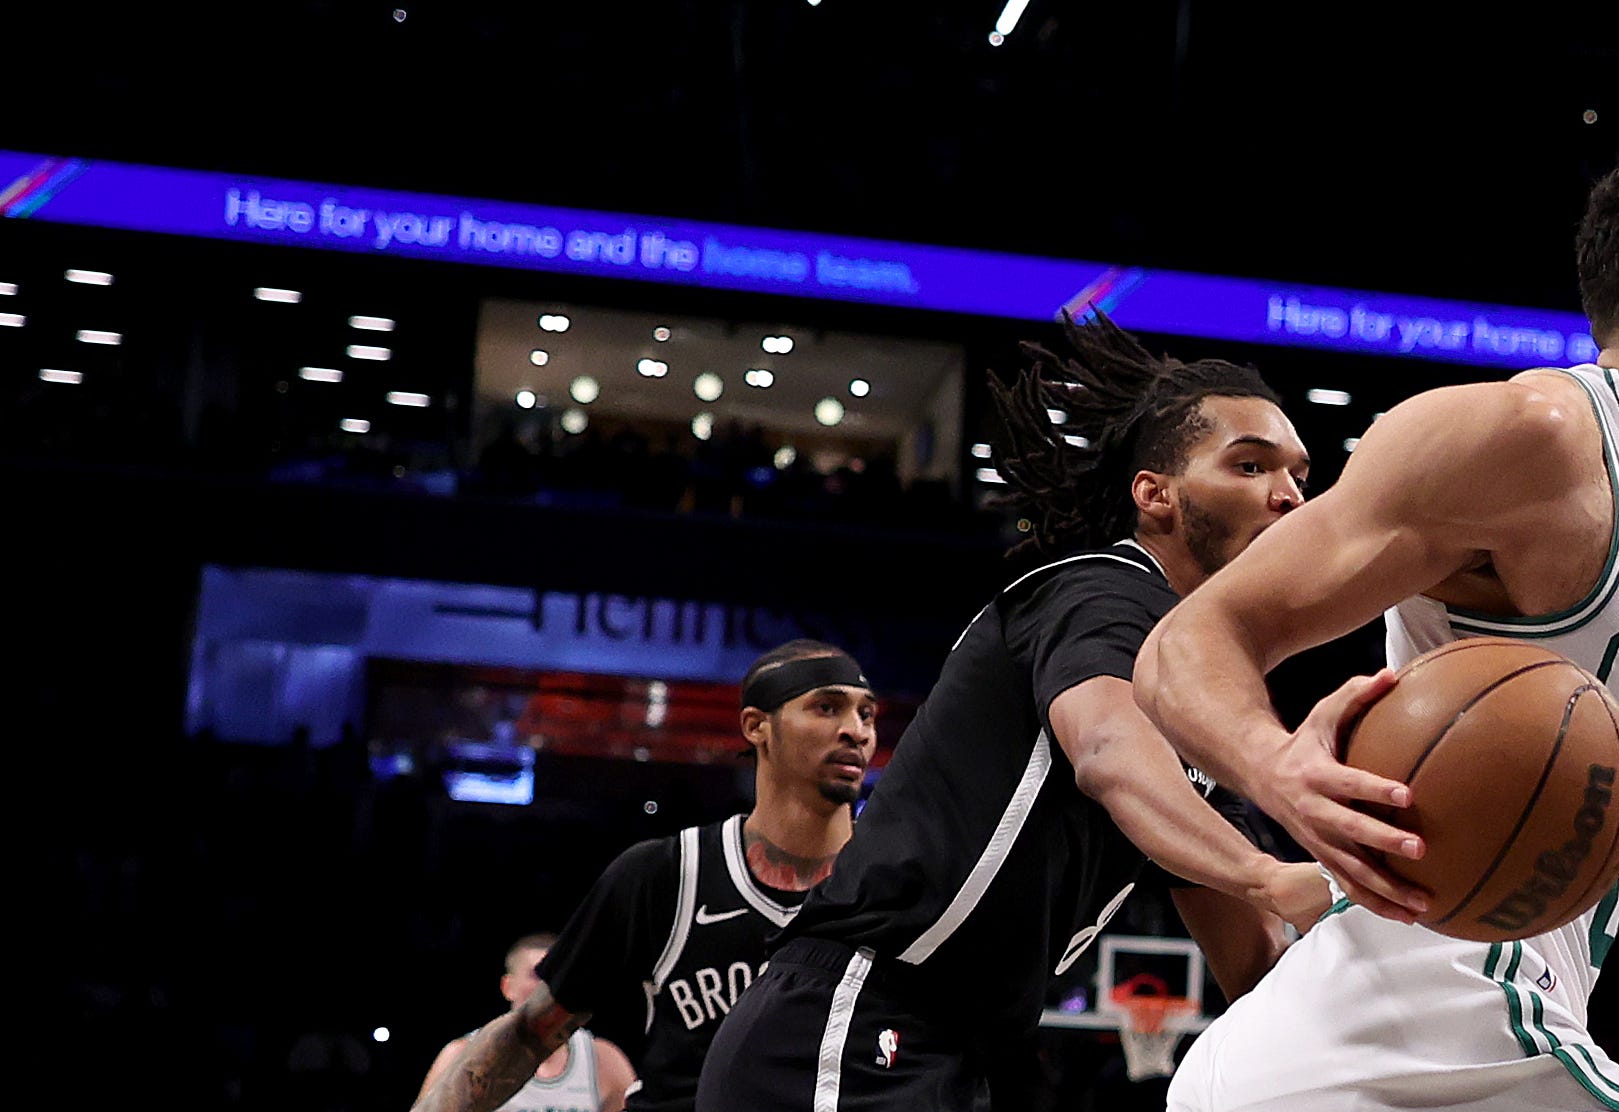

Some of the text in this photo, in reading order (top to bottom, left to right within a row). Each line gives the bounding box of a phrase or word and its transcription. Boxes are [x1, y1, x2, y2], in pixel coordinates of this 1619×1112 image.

[224, 187, 316, 233] Here
[319, 197, 371, 238] for
[373, 210, 453, 250] your
[458, 210, 564, 259] home
[564, 227, 637, 265] and
[640, 231, 699, 273] the
[1266, 293, 1349, 338] Here
[1350, 302, 1394, 342] for
[1397, 316, 1472, 353] your
[1473, 314, 1566, 362] home
